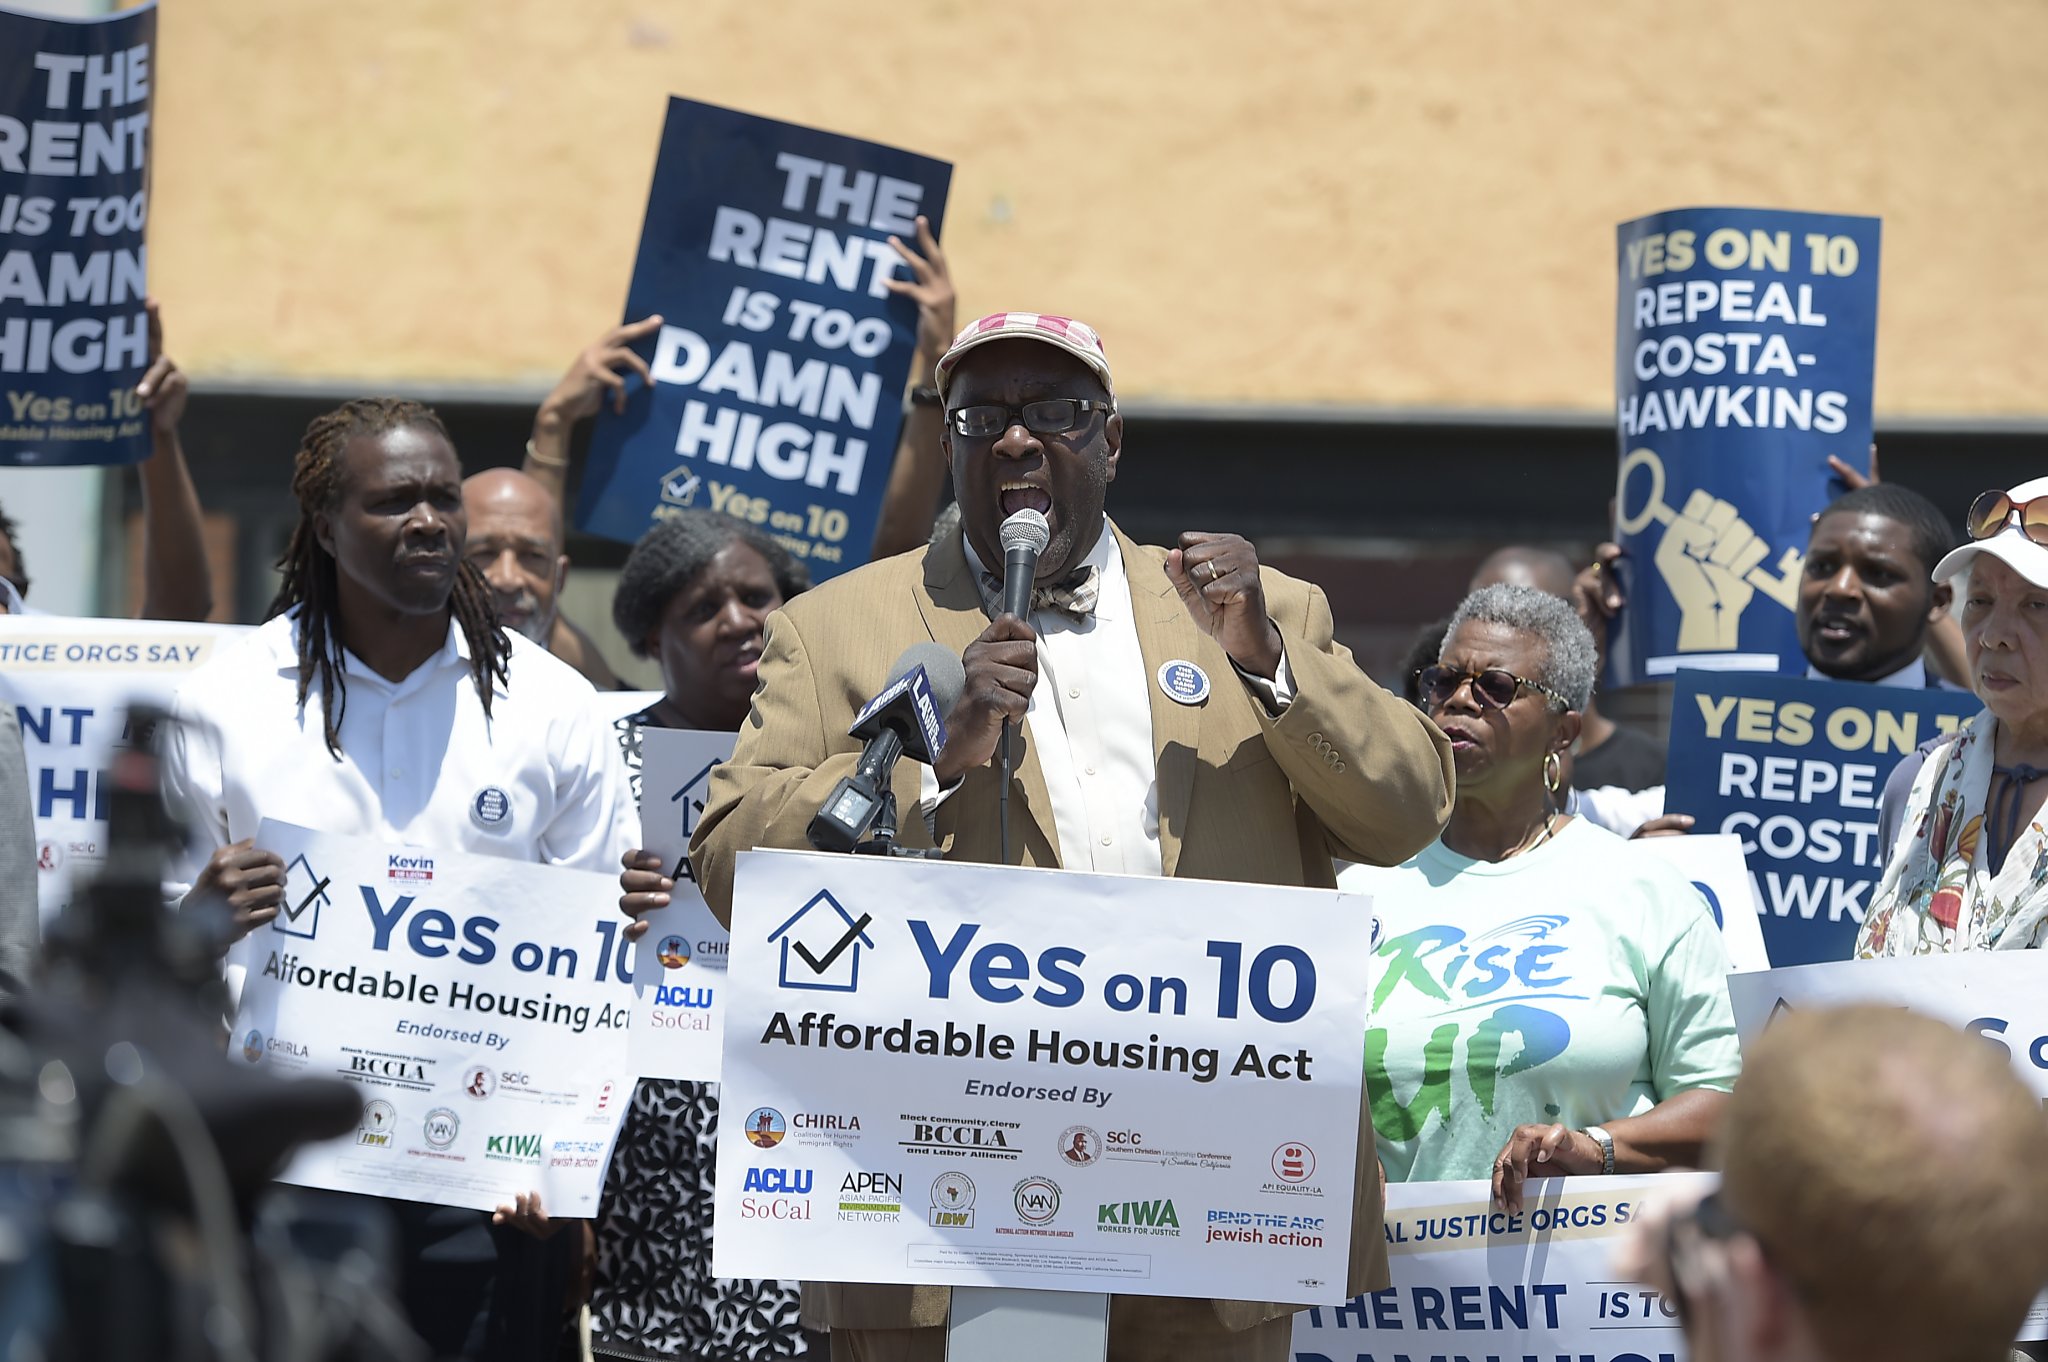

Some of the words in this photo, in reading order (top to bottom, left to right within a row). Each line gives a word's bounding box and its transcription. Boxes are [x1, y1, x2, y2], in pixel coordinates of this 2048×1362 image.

[34, 42, 150, 110] THE
[775, 151, 924, 238] THE
[0, 195, 54, 237] IS
[67, 191, 146, 238] TOO
[707, 205, 907, 299] RENT
[1627, 229, 1696, 279] YES
[1704, 228, 1791, 273] ON
[1805, 234, 1860, 277] 10
[0, 244, 146, 307] AMN
[1634, 279, 1827, 331] REPEAL
[722, 285, 781, 333] IS
[787, 300, 893, 358] TOO
[1633, 332, 1817, 381] COSTA-
[649, 324, 883, 430] DAMN
[6, 390, 71, 422] Yes
[75, 403, 106, 421] on
[110, 388, 142, 418] 10
[1618, 385, 1848, 436] HAWKINS
[675, 399, 868, 496] HIGH
[707, 480, 770, 524] Yes
[769, 510, 804, 532] on
[806, 504, 849, 541] 10
[66, 644, 140, 663] ORGS
[147, 644, 201, 663] SAY
[1695, 694, 1815, 747] YES
[1826, 706, 1918, 755] ON
[1719, 753, 1882, 810] REPE
[389, 855, 433, 869] Kevin
[358, 885, 501, 965] Yes
[511, 941, 578, 979] on
[907, 918, 1086, 1009] Yes
[1104, 972, 1188, 1016] on
[1207, 939, 1317, 1024] 10
[262, 950, 440, 1005] Affordable
[448, 981, 590, 1033] Housing
[655, 985, 713, 1009] ACLU
[396, 1020, 481, 1045] Endorsed
[485, 1033, 511, 1051] By
[651, 1010, 710, 1031] SoCal
[760, 1011, 1015, 1060] Affordable
[1027, 1028, 1219, 1082] Housing
[1231, 1044, 1313, 1082] Act
[1365, 1004, 1571, 1142] UP
[964, 1078, 1077, 1105] Endorsed
[1083, 1087, 1112, 1108] By
[793, 1113, 861, 1131] CHIRLA
[793, 1131, 822, 1139] Coalition
[913, 1124, 1008, 1147] BCCLA
[798, 1140, 832, 1148] Immigrant
[833, 1140, 853, 1149] Rights
[933, 1148, 967, 1157] Labor
[970, 1151, 1018, 1160] Alliance
[1105, 1145, 1133, 1154] Southern
[1134, 1146, 1161, 1156] Christian
[1196, 1152, 1232, 1161] Conference
[743, 1168, 813, 1194] ACLU
[840, 1172, 902, 1194] APEN
[741, 1198, 812, 1220] SoCal
[839, 1194, 866, 1202] ASIAN
[868, 1195, 901, 1203] PACIFIC
[839, 1203, 900, 1211] ENVIRONMENTAL
[1021, 1194, 1053, 1209] NAN
[1098, 1199, 1179, 1228] KIWA
[837, 1212, 900, 1222] NETWORK
[936, 1212, 968, 1225] IBW
[1097, 1225, 1131, 1233] WORKERS
[1134, 1227, 1147, 1235] FOR
[1150, 1228, 1180, 1236] JUSTICE
[1208, 1210, 1251, 1225] BEND
[1254, 1213, 1287, 1227] THE
[1290, 1216, 1324, 1231] ARC
[1414, 1211, 1524, 1242] JUSTICE
[1531, 1204, 1607, 1231] ORGS
[1206, 1226, 1262, 1243] jewish
[1268, 1232, 1322, 1247] action
[1412, 1284, 1567, 1330] RENT
[1599, 1292, 1630, 1319] IS
[1639, 1291, 1679, 1319] TO
